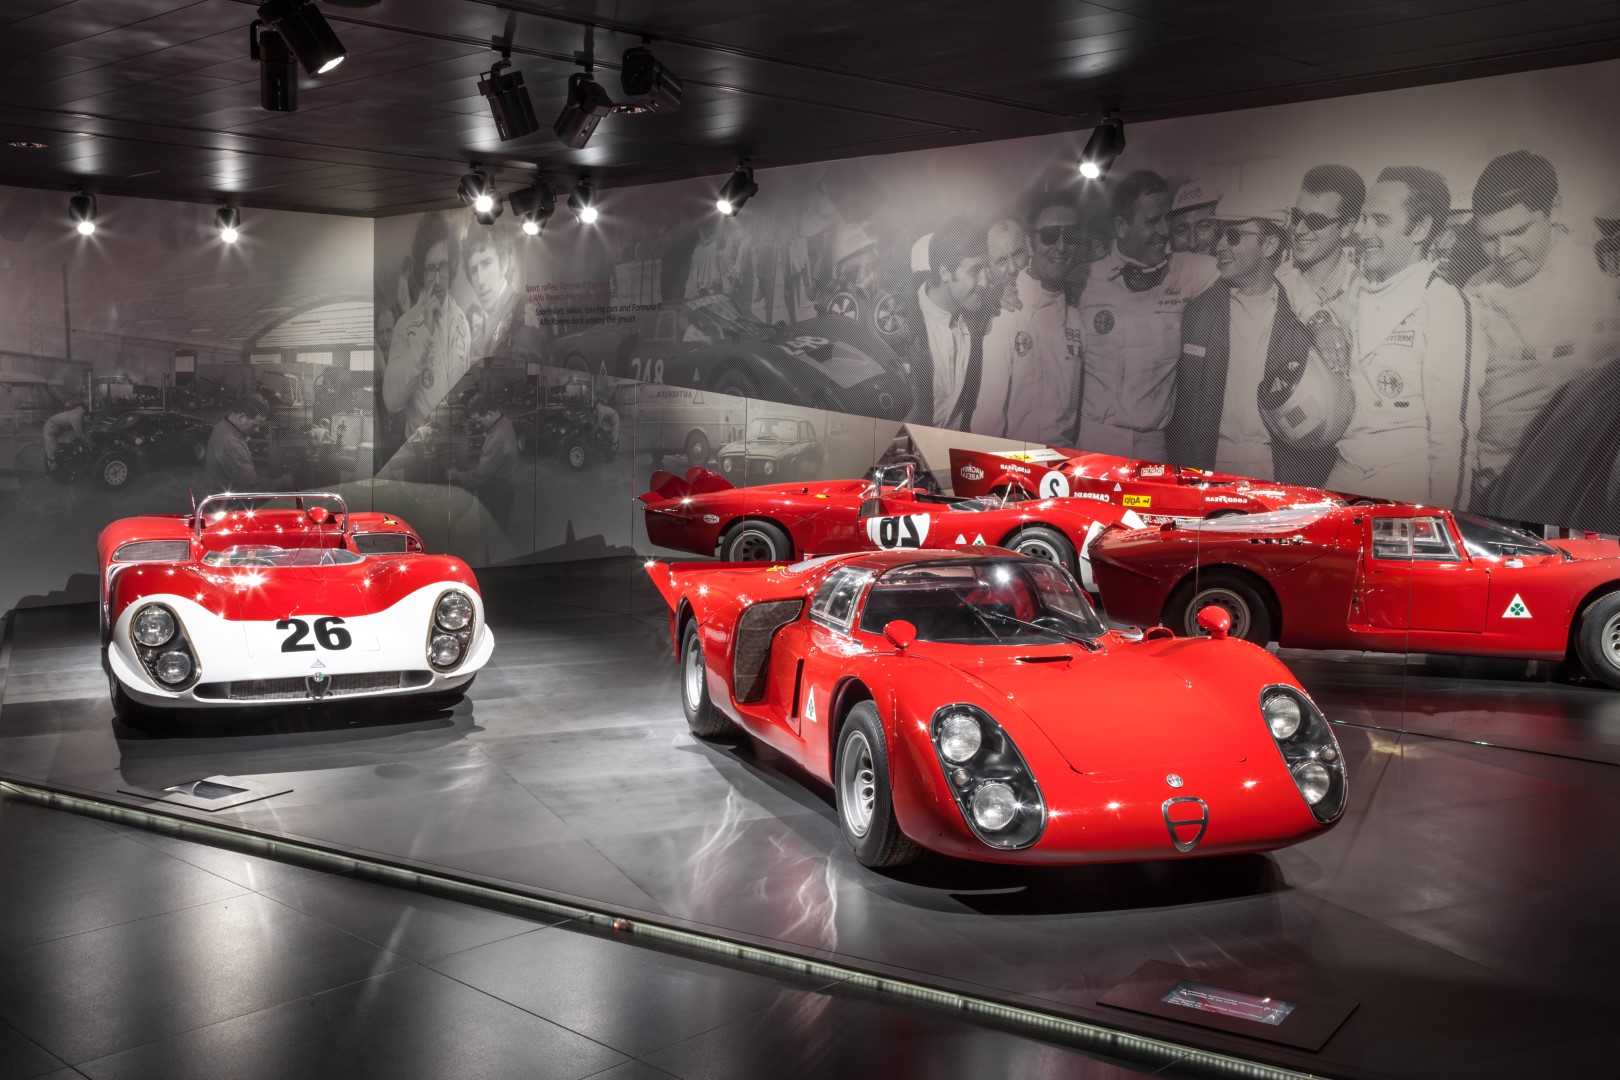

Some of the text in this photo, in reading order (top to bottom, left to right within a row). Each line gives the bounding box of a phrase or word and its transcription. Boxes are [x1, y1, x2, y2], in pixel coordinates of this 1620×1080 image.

[535, 307, 552, 317] Sports
[584, 305, 606, 315] touring
[619, 304, 631, 313] and
[631, 302, 657, 312] Formula
[539, 318, 551, 326] Alfa
[552, 317, 571, 326] Romeo
[571, 316, 584, 325] back
[585, 316, 606, 326] among
[606, 315, 616, 324] the
[276, 616, 352, 653] 26
